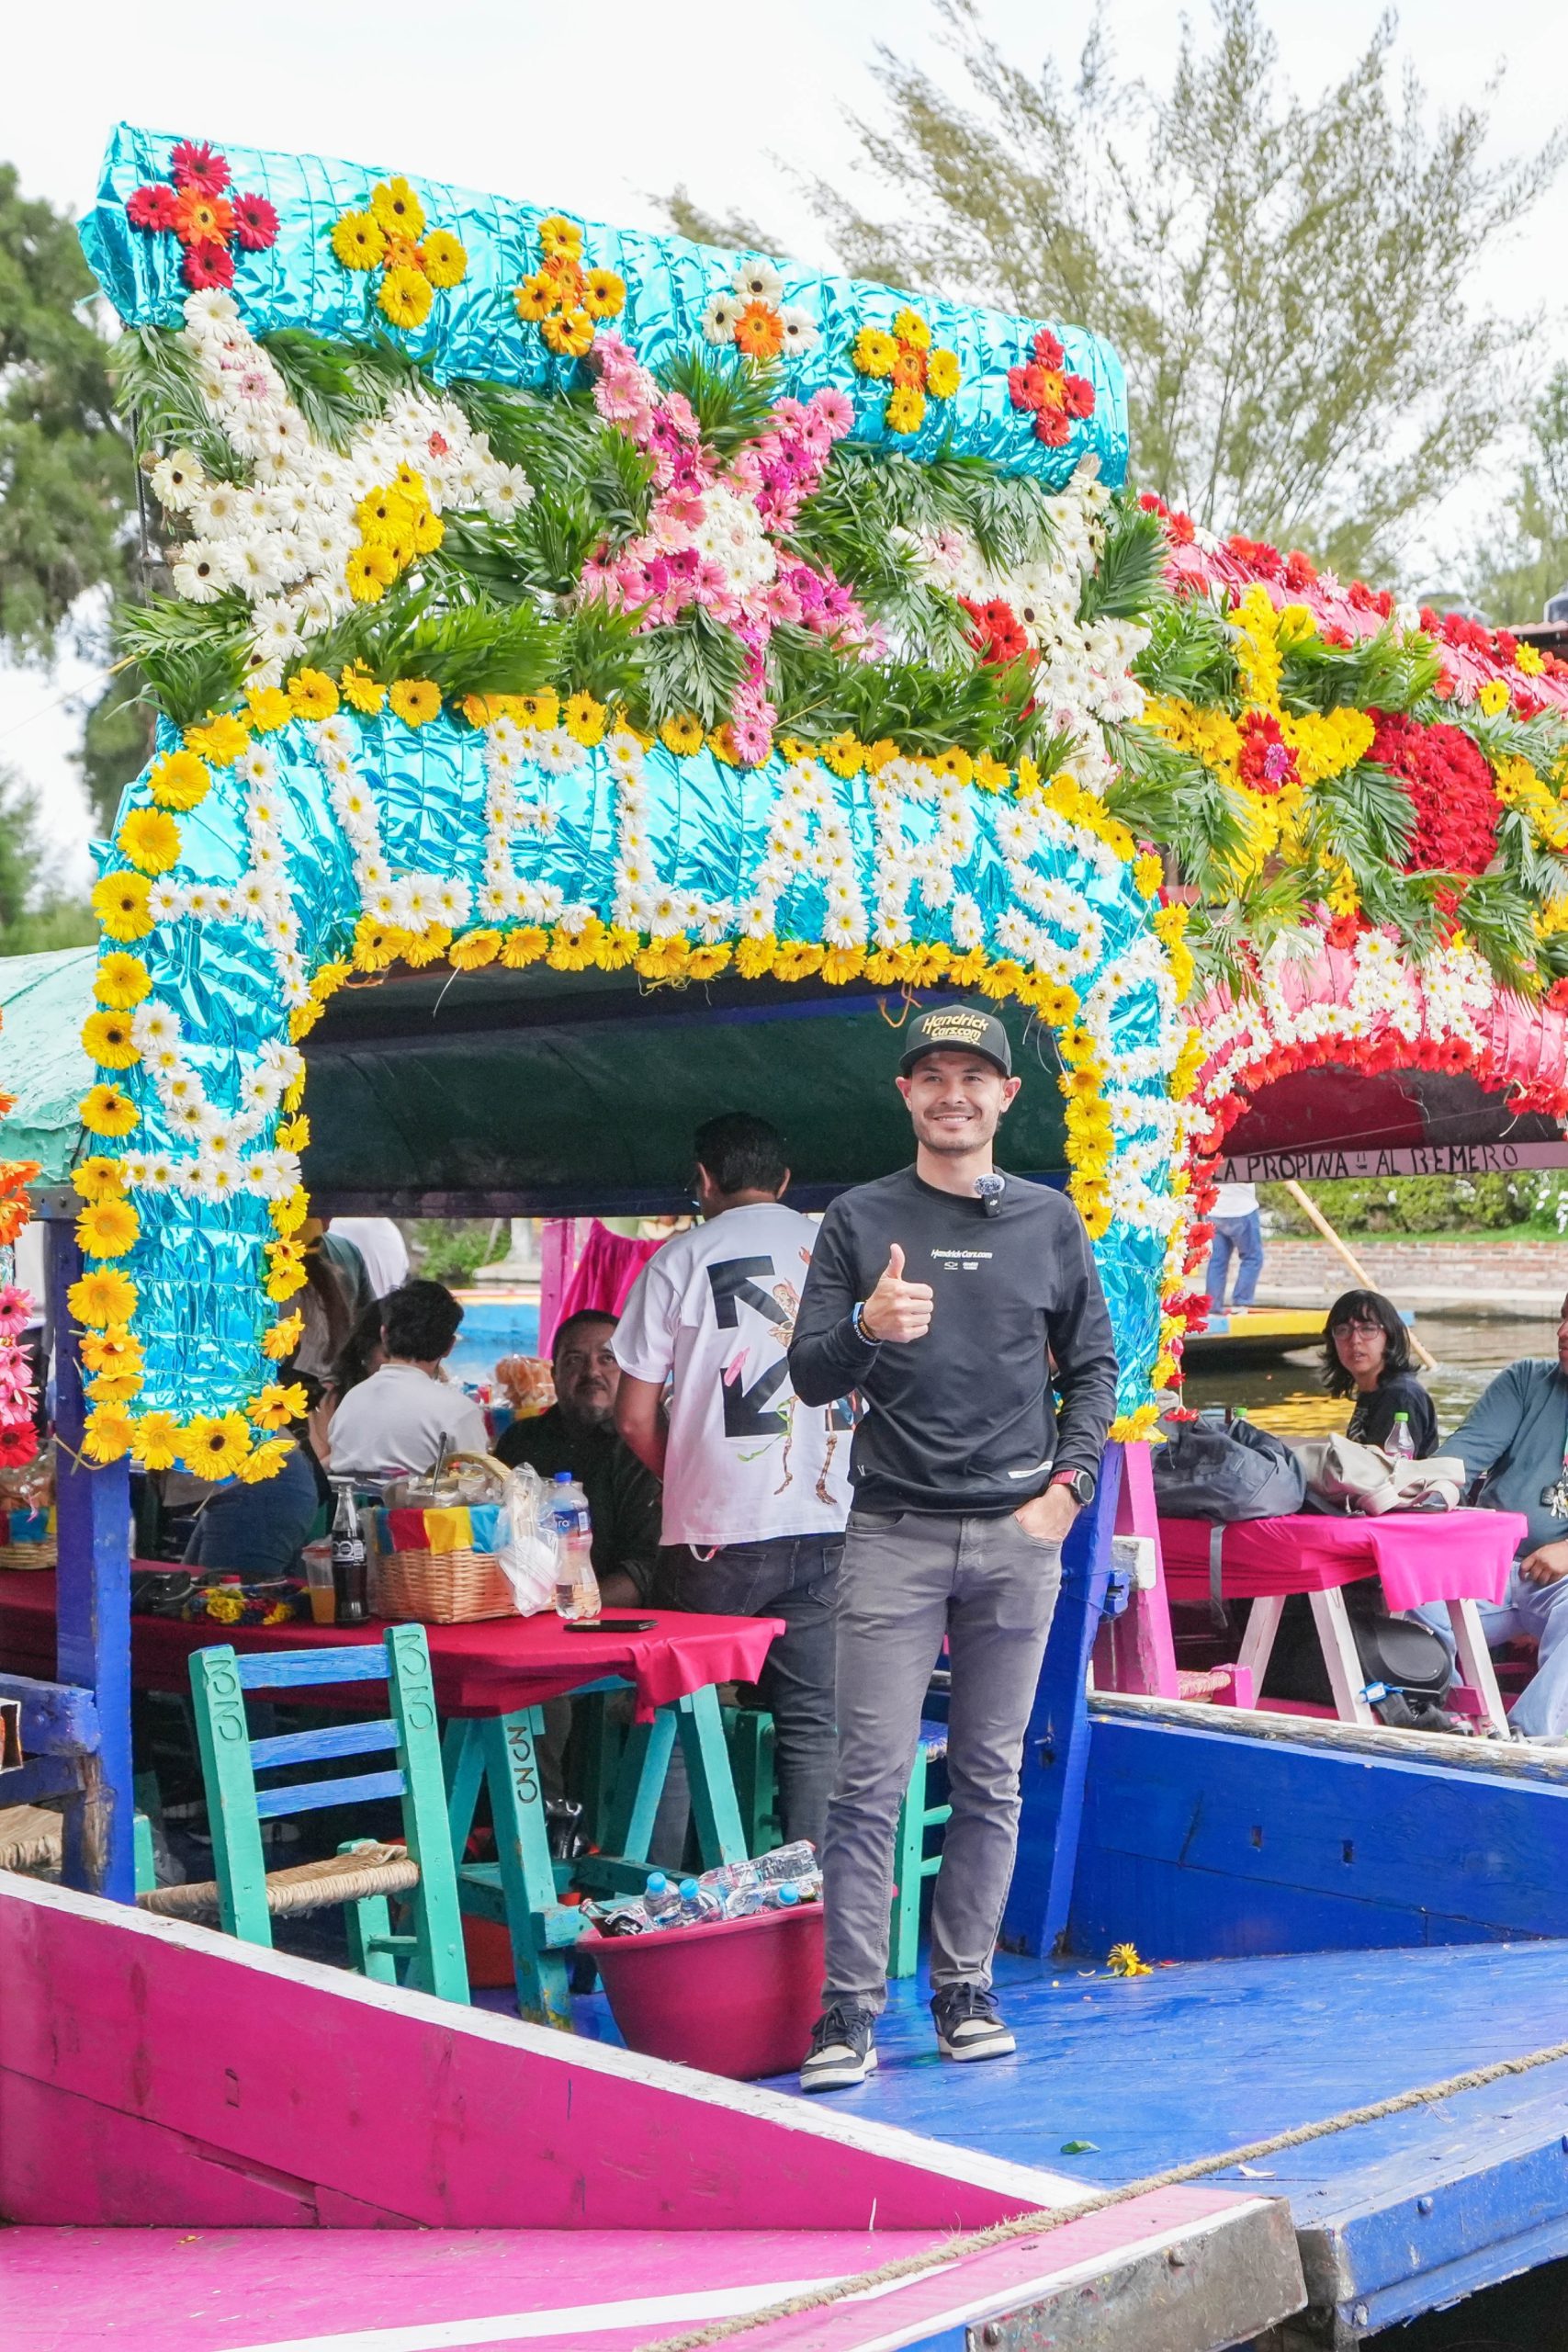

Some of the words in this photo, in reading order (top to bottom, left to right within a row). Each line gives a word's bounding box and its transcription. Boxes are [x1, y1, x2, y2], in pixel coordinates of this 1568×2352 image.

[921, 1013, 989, 1035] Hendrick
[931, 1026, 982, 1042] Cars.com
[1247, 1150, 1349, 1182] PROPINA
[1376, 1148, 1402, 1176] AL
[1410, 1144, 1518, 1174] REMERO
[931, 1249, 993, 1260] HendrickCars.com
